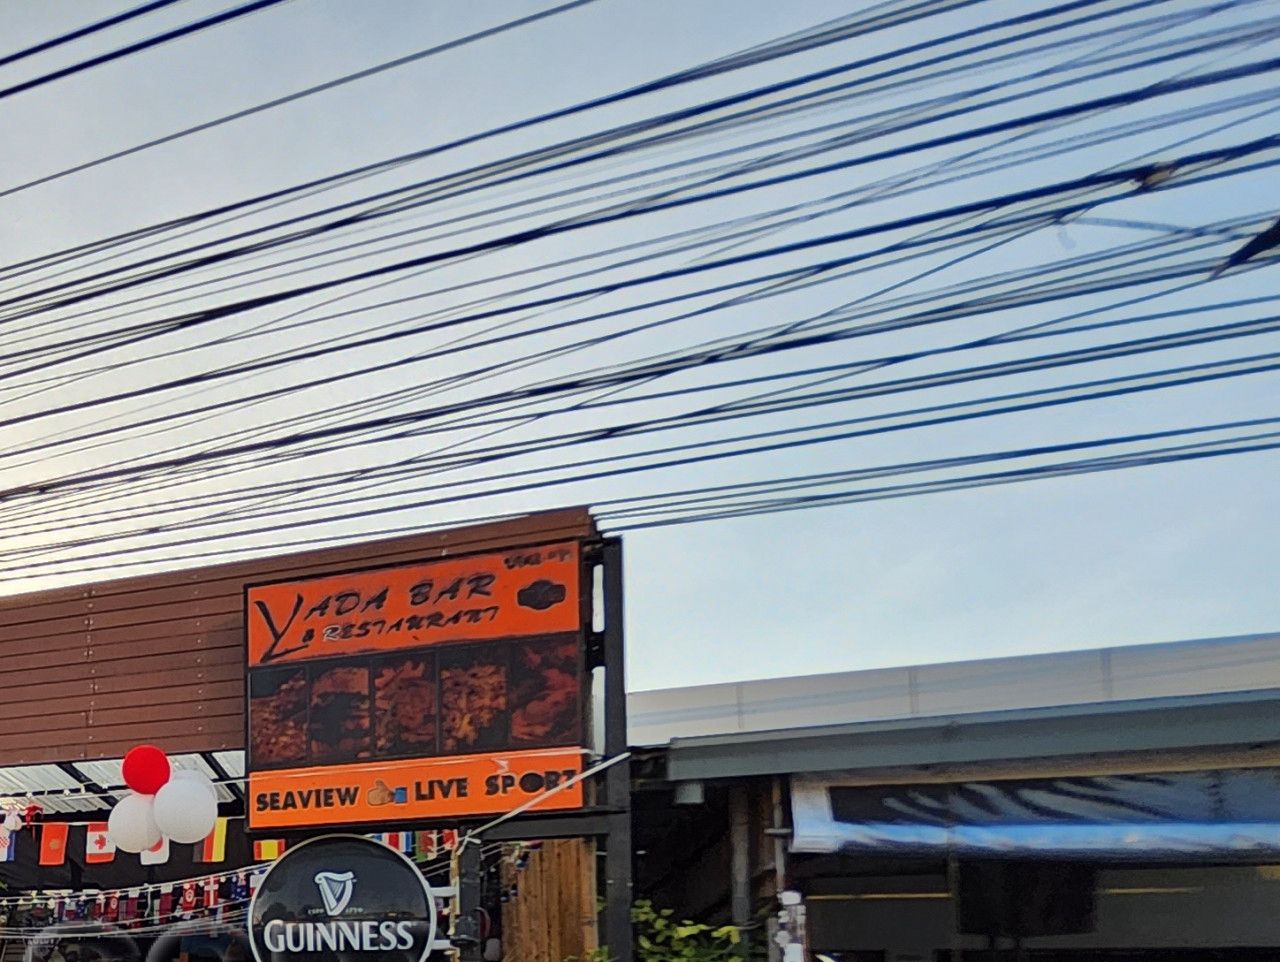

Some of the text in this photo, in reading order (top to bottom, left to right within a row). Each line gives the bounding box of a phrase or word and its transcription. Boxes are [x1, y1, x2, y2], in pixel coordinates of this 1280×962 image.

[409, 573, 496, 606] BAR
[323, 606, 499, 642] RESTAURANT
[256, 786, 360, 812] SEAVIEW
[415, 778, 469, 801] LIVE
[263, 919, 414, 952] GUINNESS
